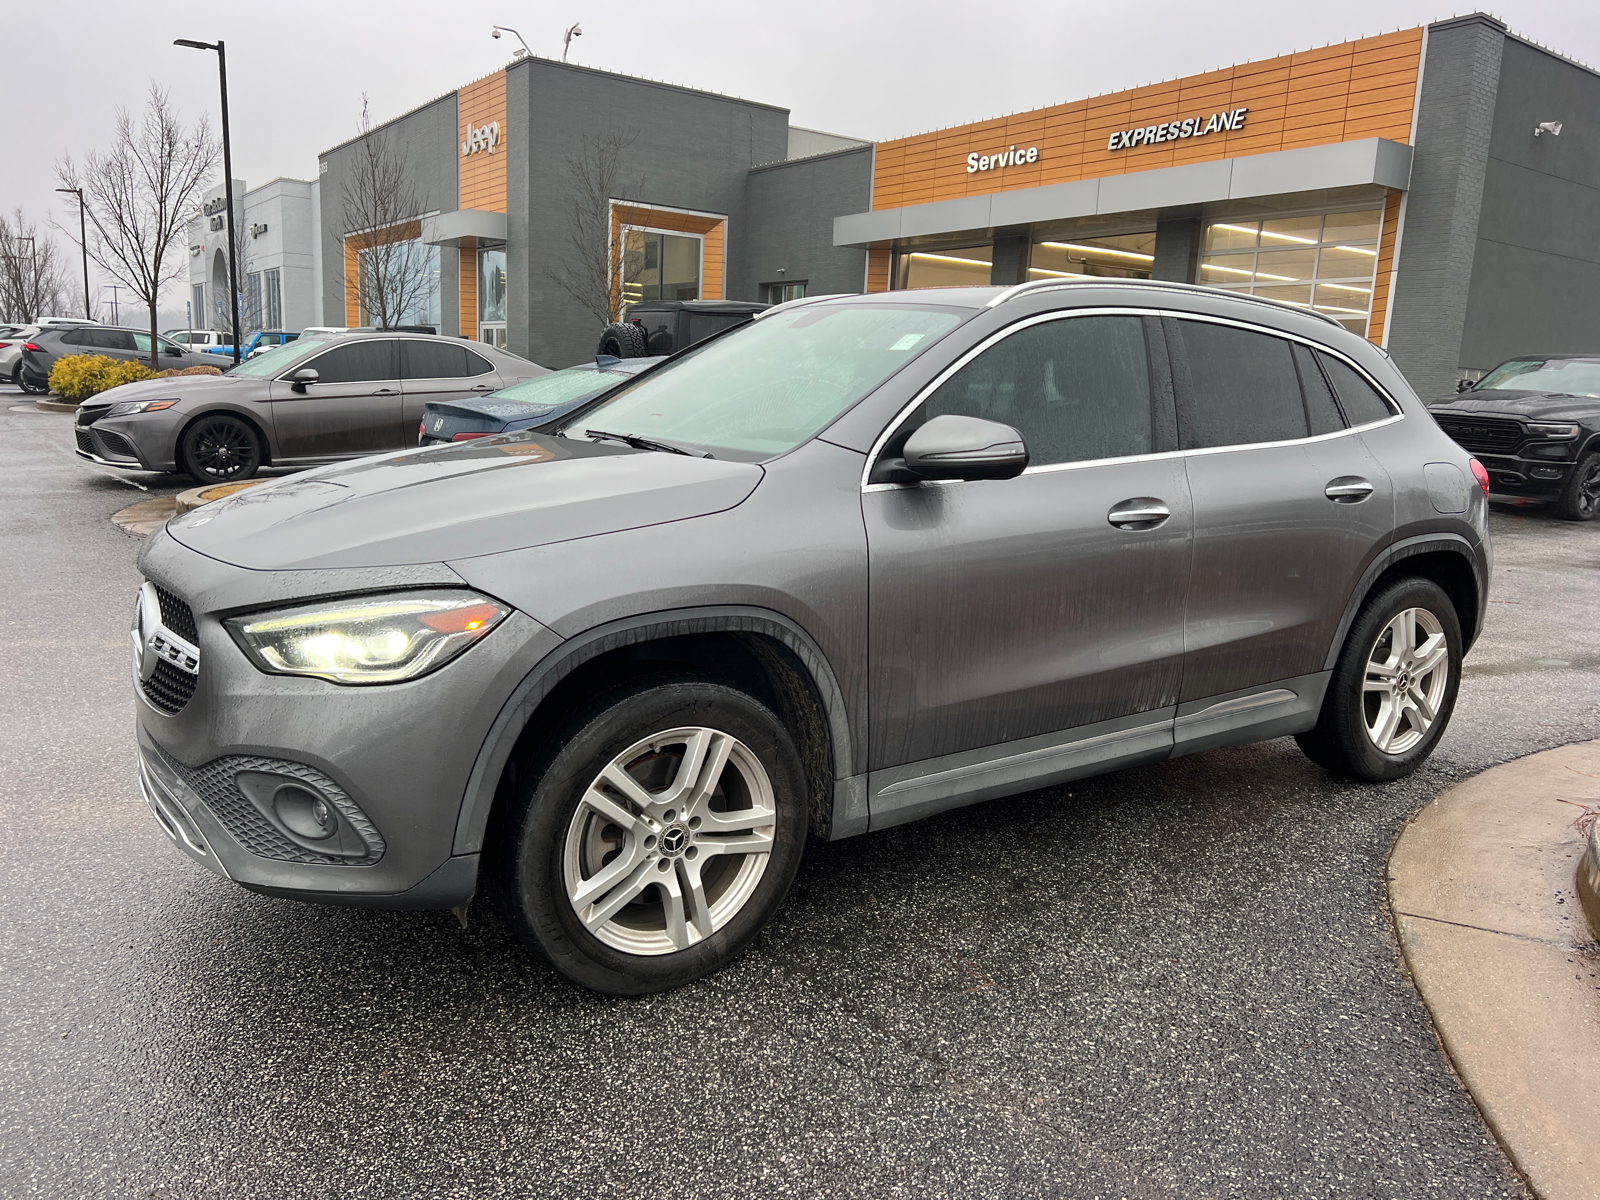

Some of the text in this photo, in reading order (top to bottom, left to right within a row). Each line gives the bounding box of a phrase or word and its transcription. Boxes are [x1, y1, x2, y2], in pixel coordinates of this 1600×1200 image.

[462, 120, 499, 156] Jeep
[1107, 107, 1248, 151] EXPRESSLANE
[966, 145, 1038, 173] Service
